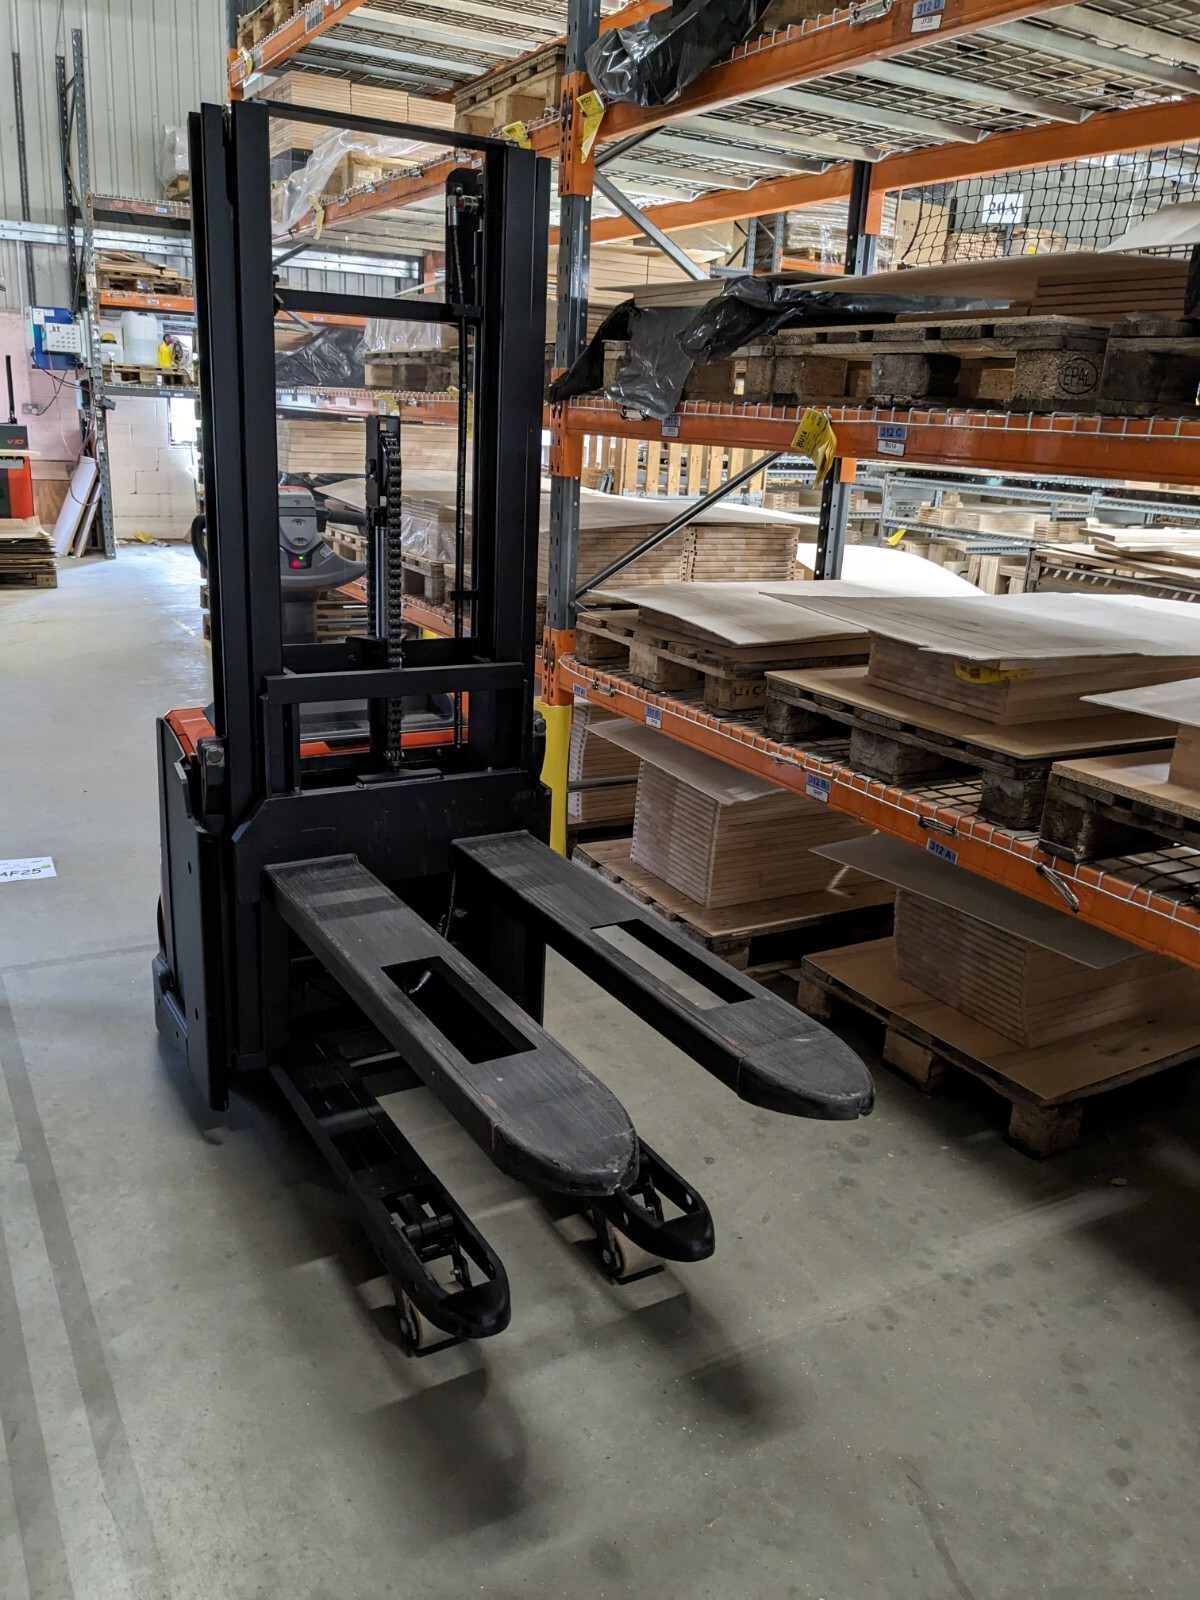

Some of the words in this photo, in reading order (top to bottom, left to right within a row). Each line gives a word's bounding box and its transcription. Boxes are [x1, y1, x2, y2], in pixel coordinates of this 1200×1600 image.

[917, 2, 932, 14] 312
[1063, 366, 1092, 387] EPAL
[796, 430, 808, 448] BU14
[880, 427, 894, 437] 312
[895, 427, 902, 437] C
[930, 841, 944, 855] 312
[944, 850, 951, 860] A
